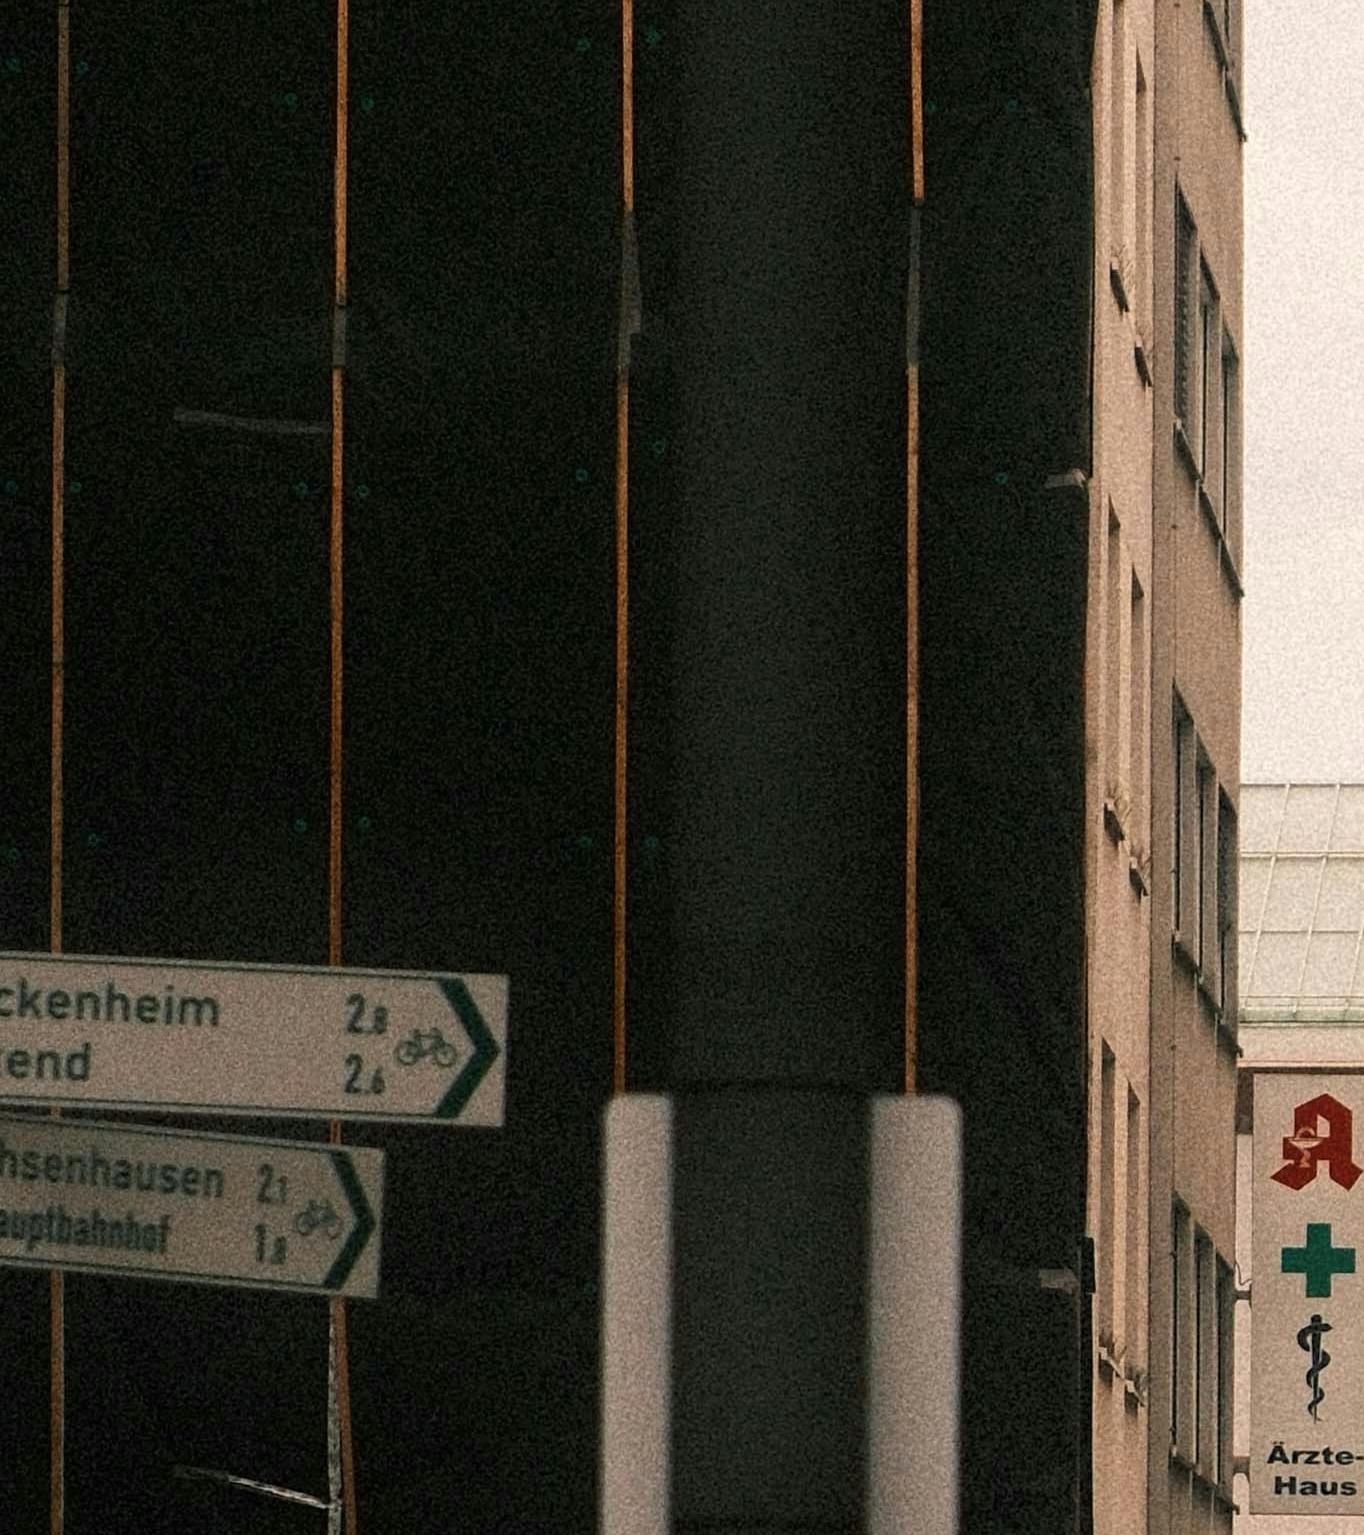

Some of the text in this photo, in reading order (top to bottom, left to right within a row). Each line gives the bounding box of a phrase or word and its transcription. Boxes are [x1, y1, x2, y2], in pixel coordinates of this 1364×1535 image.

[0, 977, 220, 1025] ckenheim
[1266, 1441, 1364, 1466] Ärzte-
[1274, 1476, 1357, 1497] Haus
